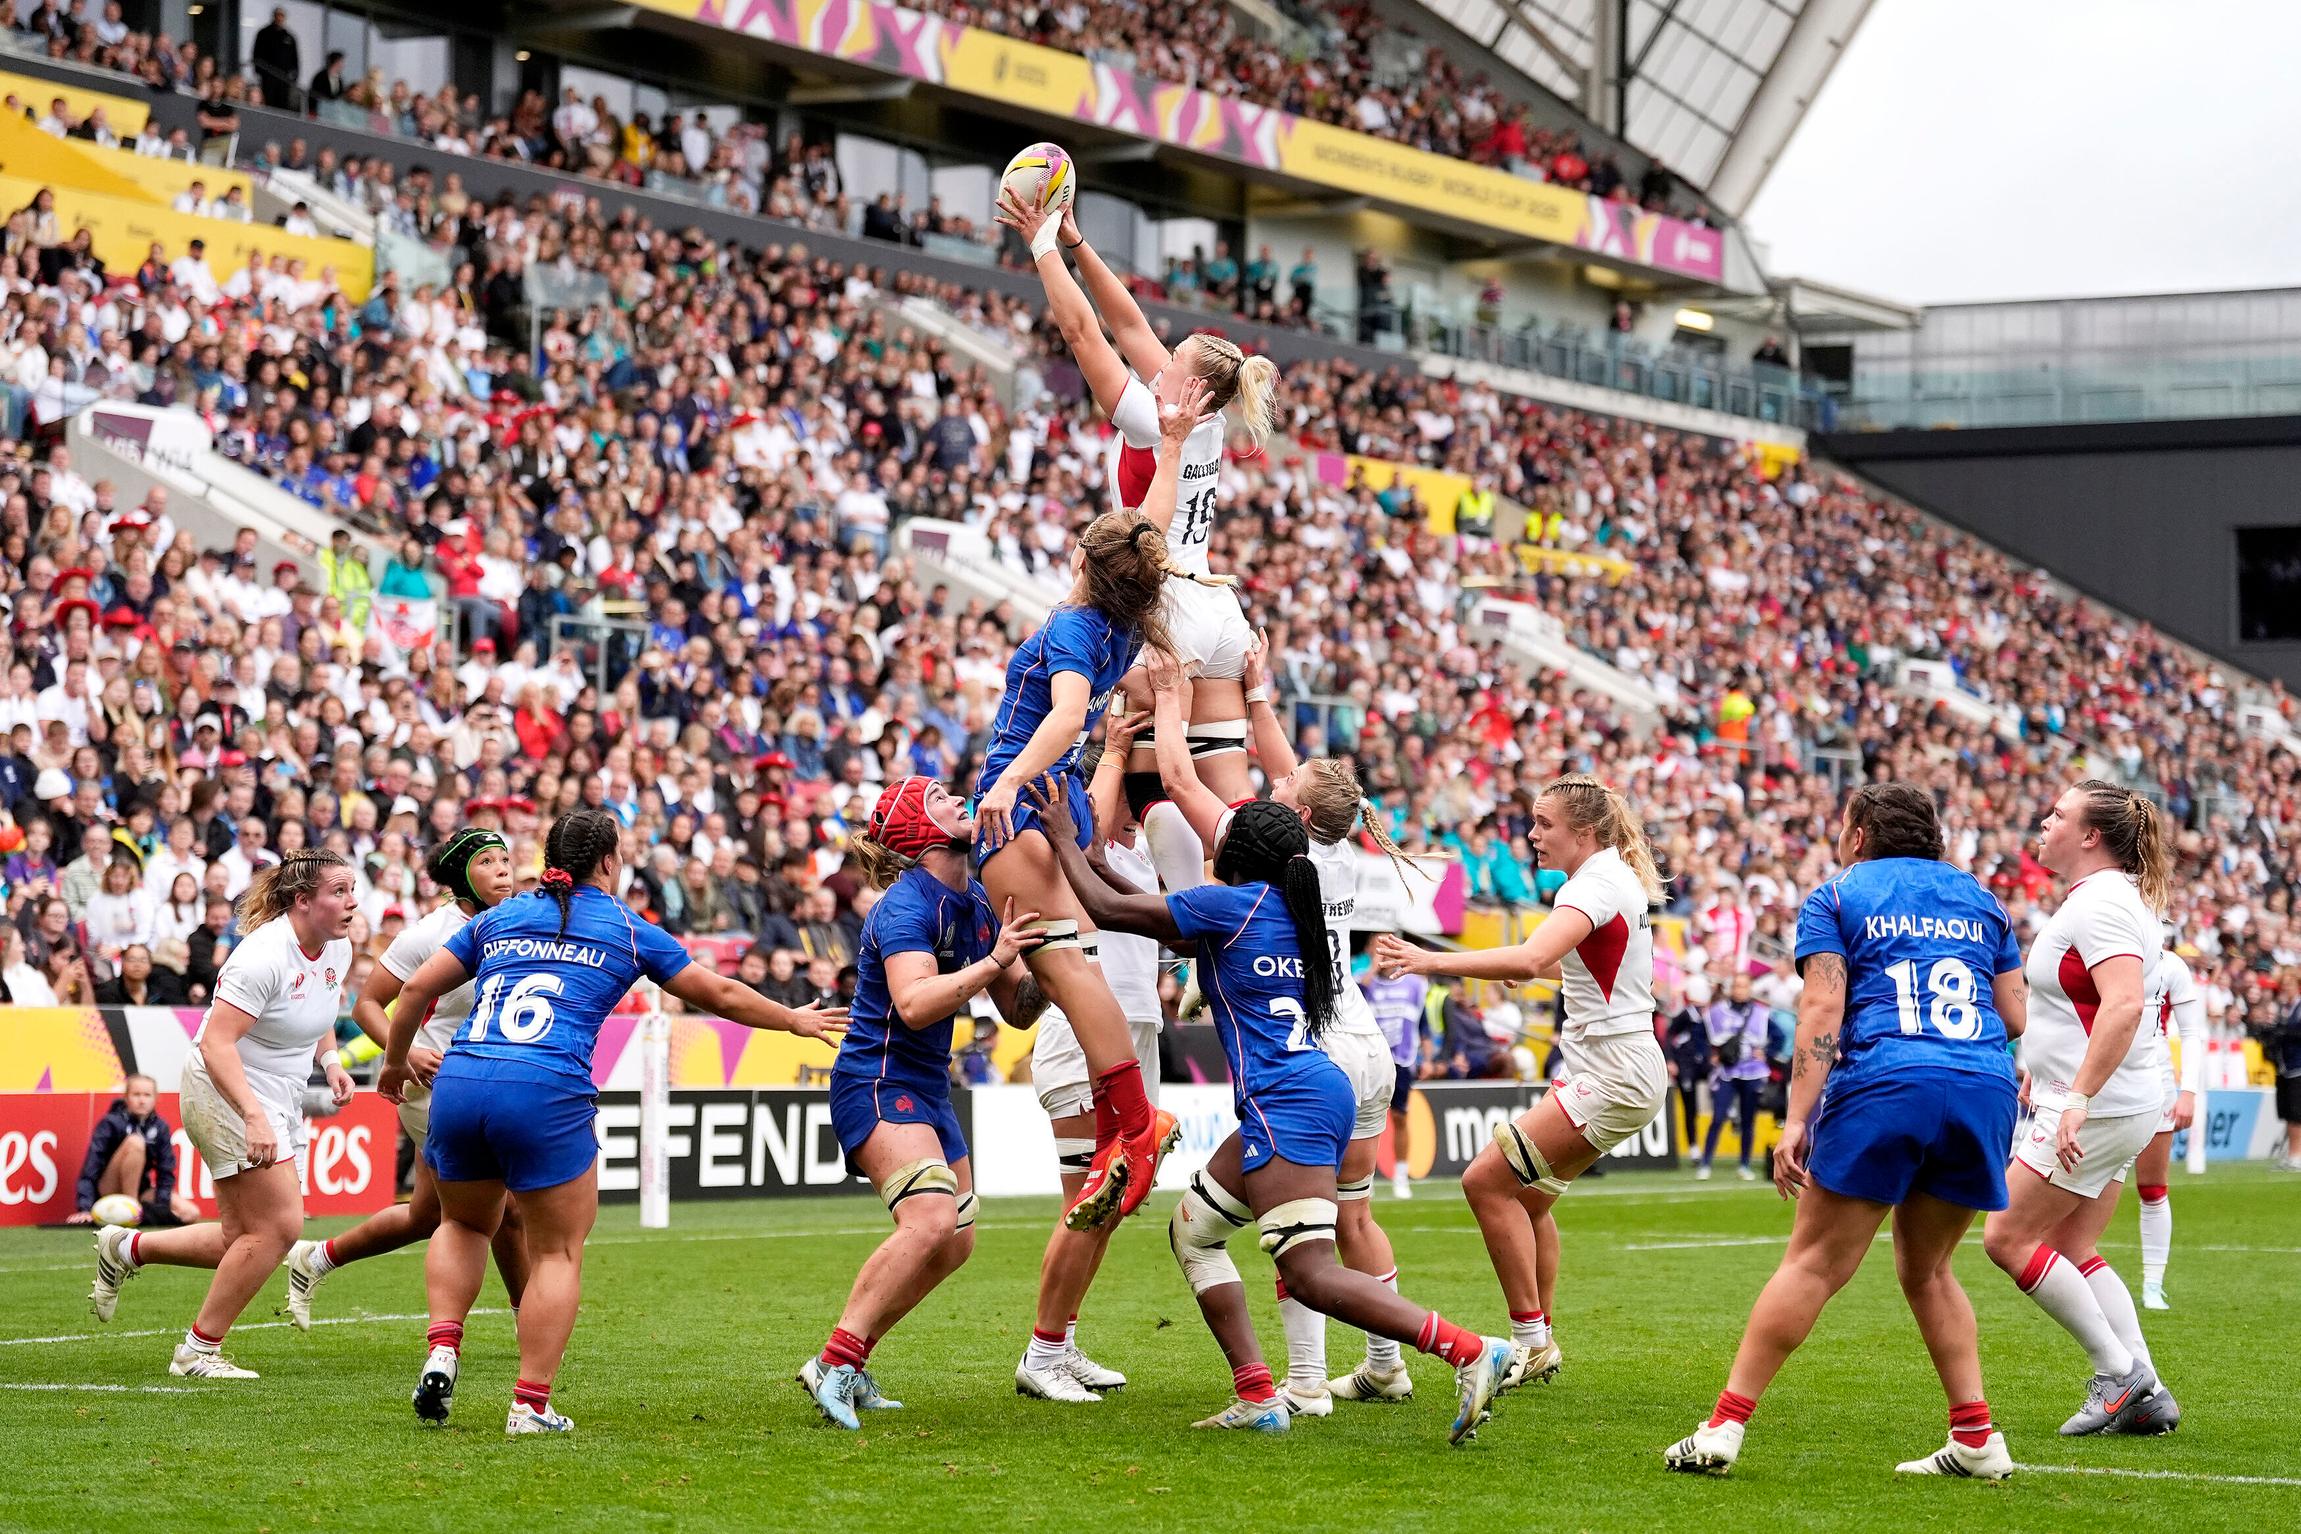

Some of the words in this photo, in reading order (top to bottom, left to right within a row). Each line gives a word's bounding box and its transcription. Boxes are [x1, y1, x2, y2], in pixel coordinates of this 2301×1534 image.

[1182, 458, 1221, 480] GALLIGA
[1865, 914, 1985, 945] KHALFAOUI
[1253, 955, 1306, 979] OKE
[467, 972, 565, 1044] 16
[1884, 957, 1983, 1041] 18
